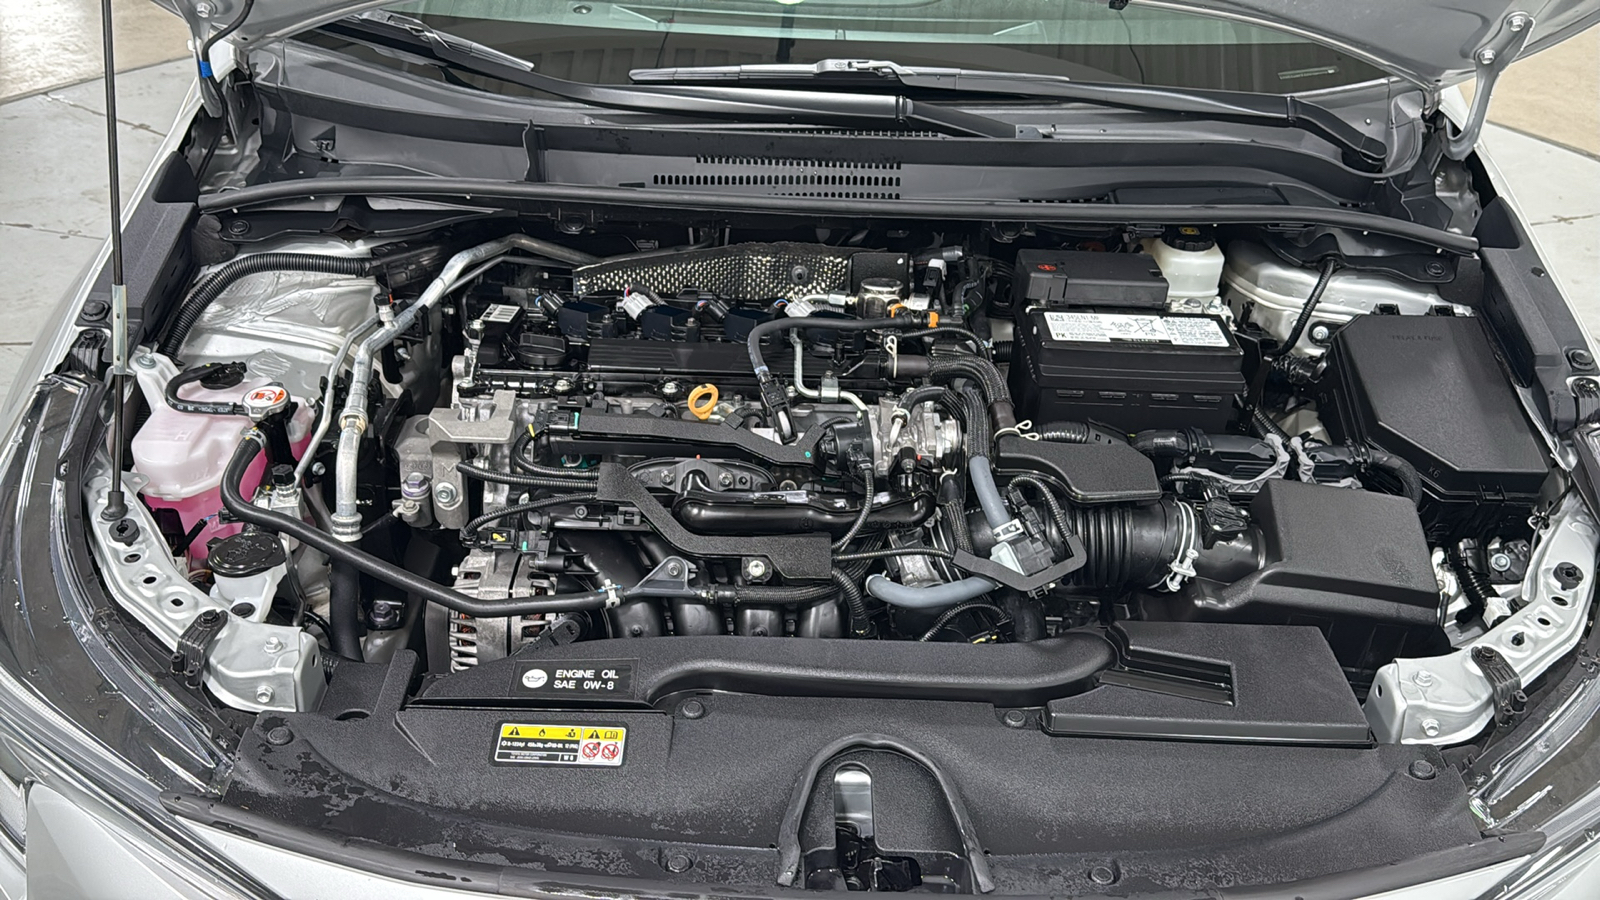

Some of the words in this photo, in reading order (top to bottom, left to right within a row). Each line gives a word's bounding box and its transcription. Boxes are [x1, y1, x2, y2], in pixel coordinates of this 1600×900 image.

[555, 669, 596, 679] ENGINE
[601, 669, 619, 679] OIL
[553, 680, 577, 689] SAE
[583, 680, 614, 690] 0W-8
